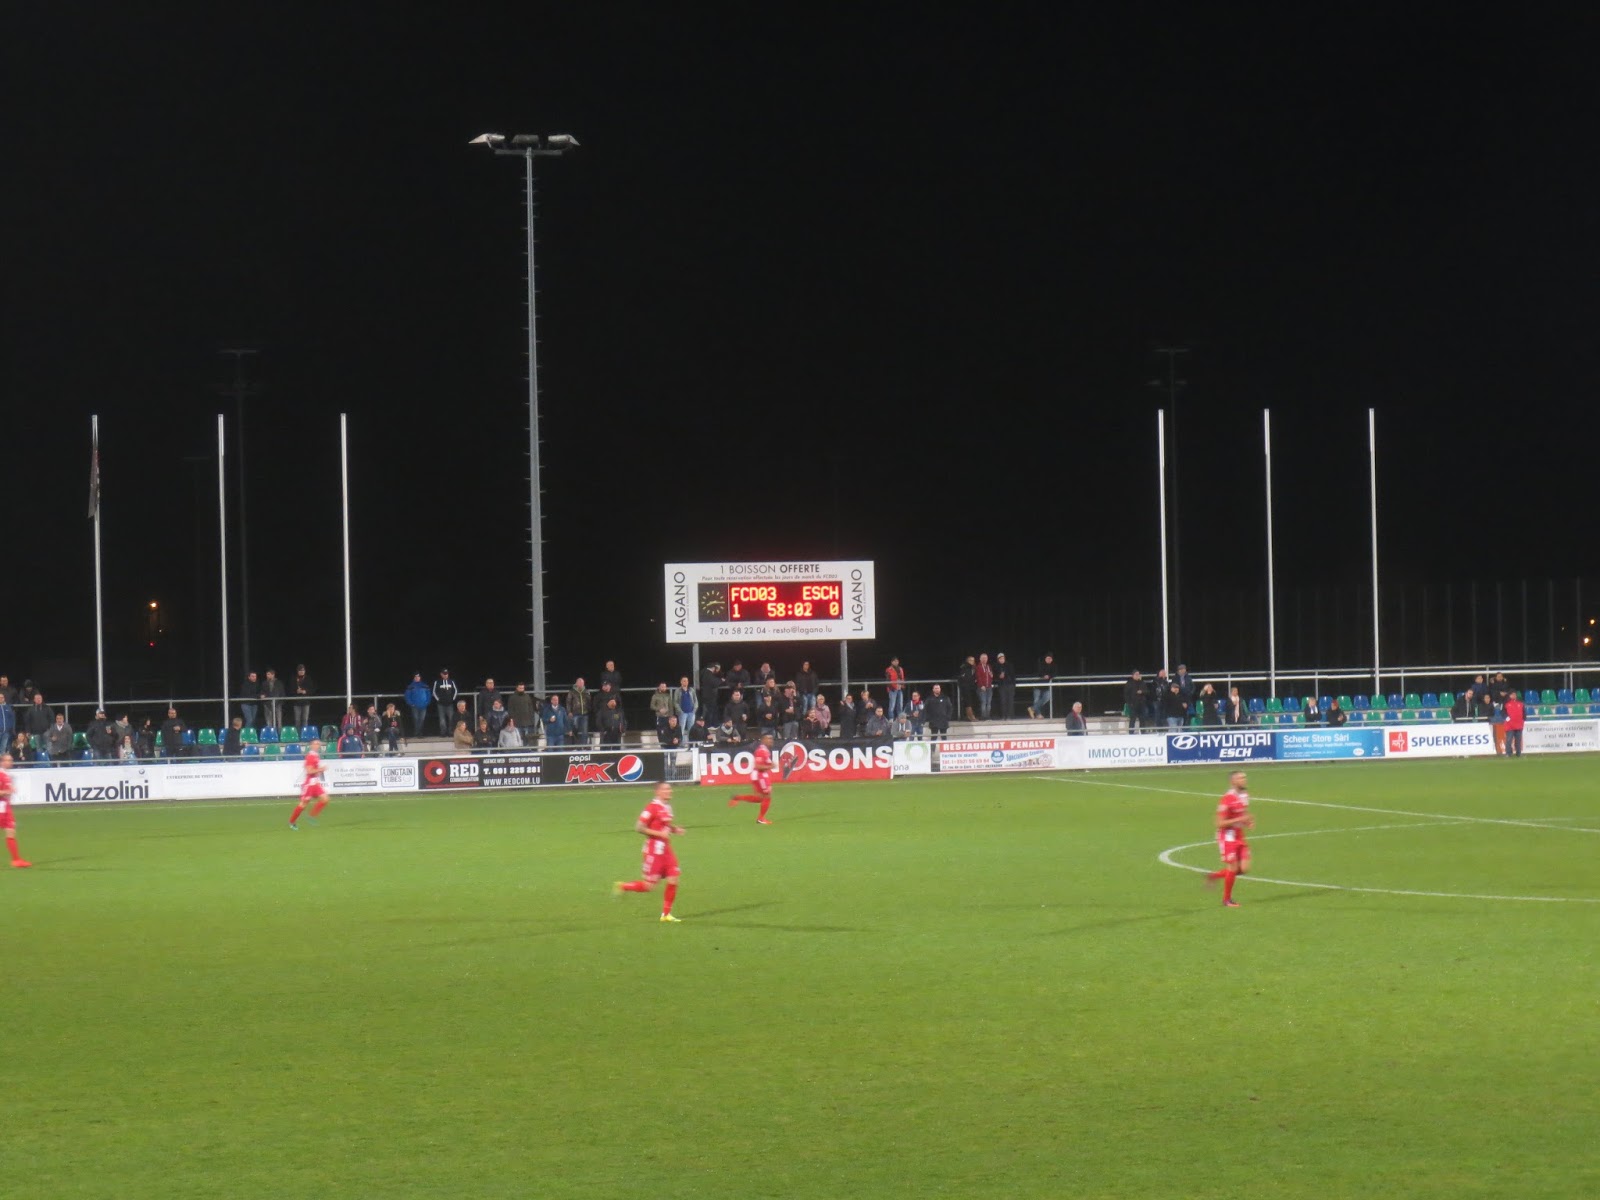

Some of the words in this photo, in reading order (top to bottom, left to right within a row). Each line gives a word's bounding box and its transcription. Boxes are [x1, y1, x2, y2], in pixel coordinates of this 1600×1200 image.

[720, 565, 724, 573] 1
[729, 565, 776, 574] BOISSON
[779, 564, 820, 573] OFFERTE
[730, 586, 778, 602] FCD03
[802, 585, 839, 600] ESCH
[850, 568, 864, 632] LAGANO
[673, 571, 687, 635] LAGANO
[732, 603, 741, 618] 1
[767, 602, 813, 617] 58:02
[829, 601, 839, 616] 0
[710, 627, 717, 635] T.
[719, 627, 729, 635] 26
[732, 627, 742, 635] 58
[744, 626, 754, 634] 22
[756, 626, 766, 634] 04
[772, 625, 833, 635] resto@lagano.lu
[943, 742, 1005, 751] RESTAURANT
[1010, 739, 1051, 749] PENALTY
[1200, 733, 1272, 748] HYUNDAI
[1283, 734, 1310, 744] Scheer
[1311, 734, 1332, 743] Store
[1411, 734, 1490, 747] SPUERKEESS
[569, 754, 591, 763] pepsi
[808, 745, 893, 771] SONS
[1088, 746, 1164, 759] IMMOTOP.LU
[1219, 747, 1252, 758] ESCH
[383, 767, 413, 776] LONGTAIN
[449, 763, 479, 777] RED
[483, 767, 491, 775] T.
[509, 766, 525, 774] 225
[565, 762, 616, 783] MAX
[483, 777, 541, 786] WWW.REDCOM.LU
[45, 780, 150, 802] Muzzolini
